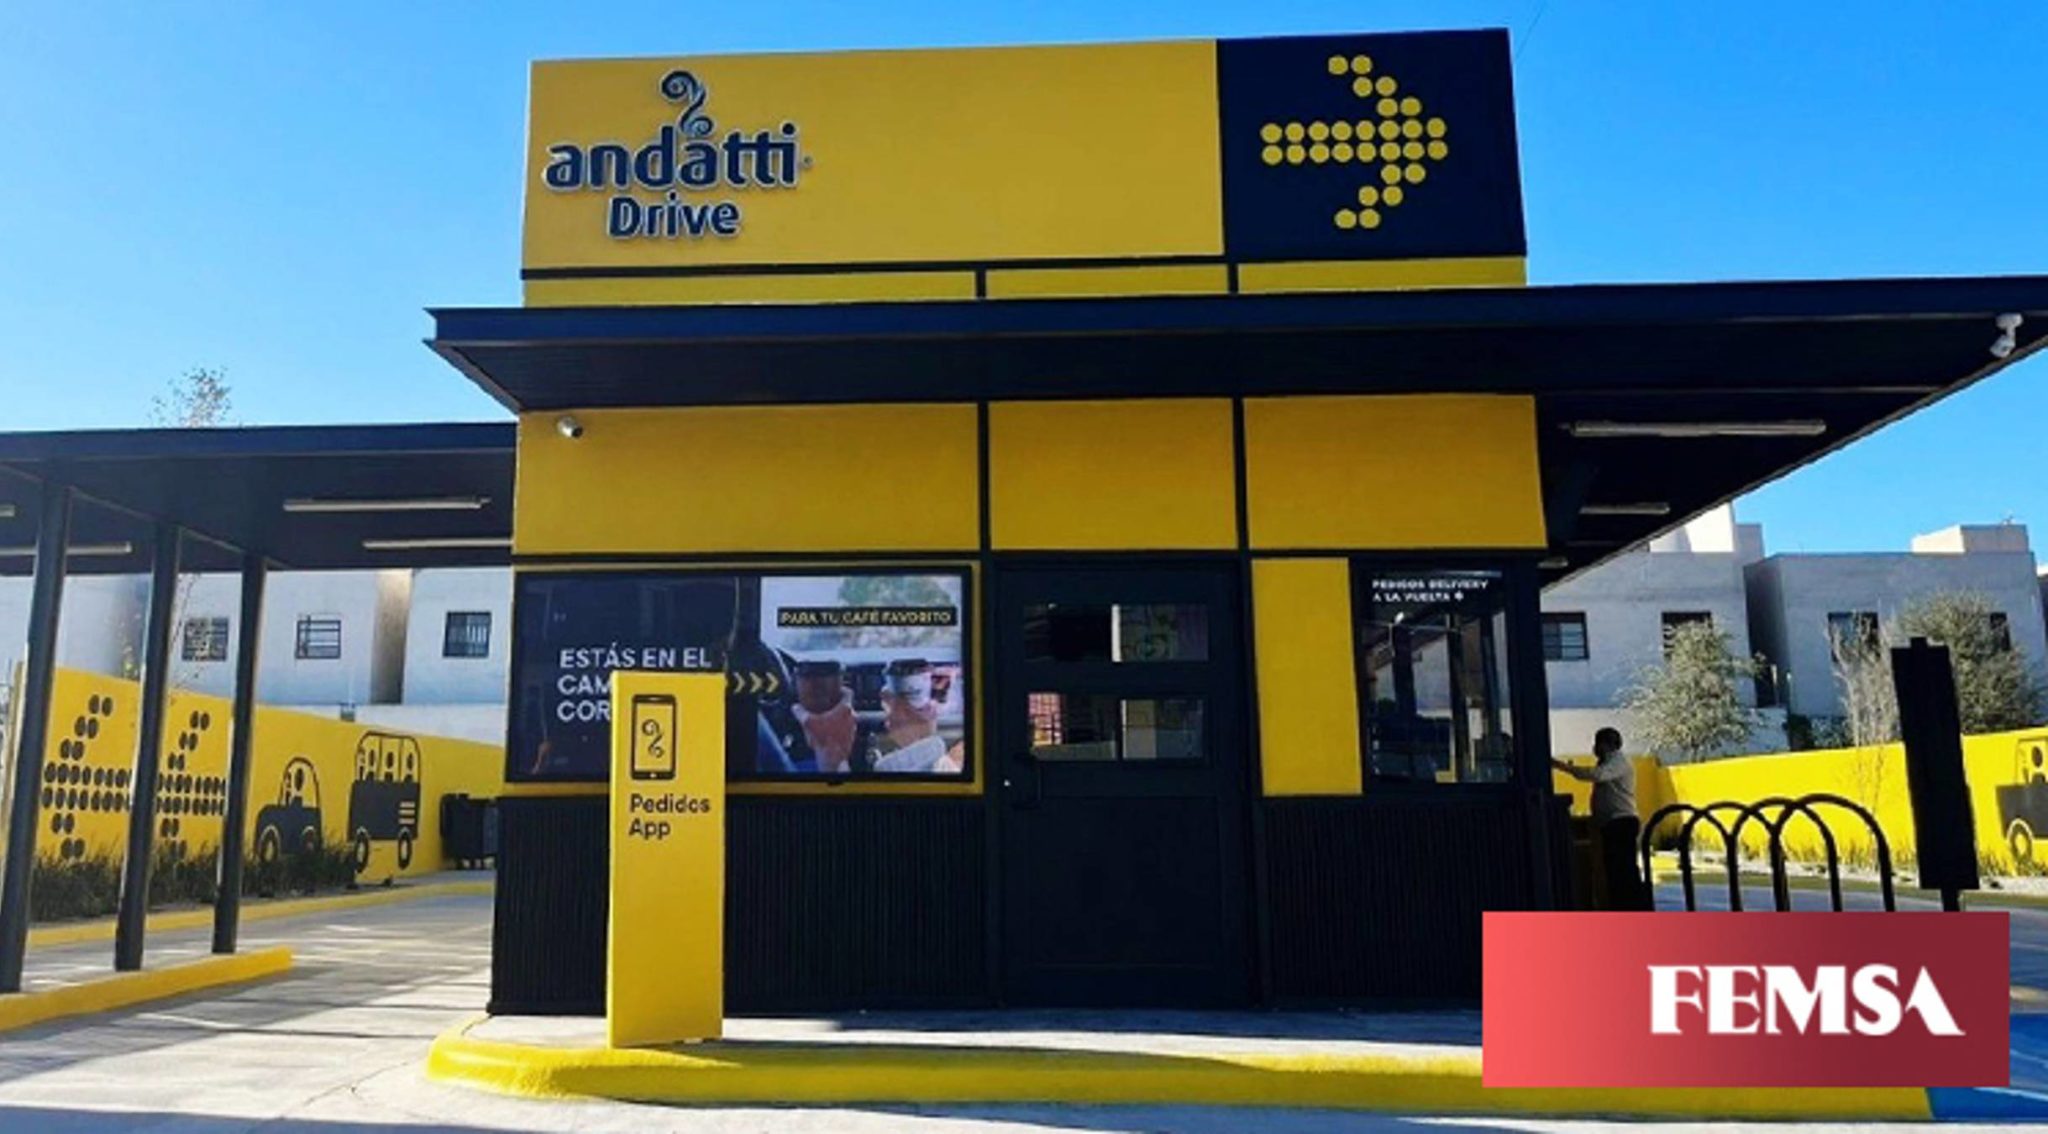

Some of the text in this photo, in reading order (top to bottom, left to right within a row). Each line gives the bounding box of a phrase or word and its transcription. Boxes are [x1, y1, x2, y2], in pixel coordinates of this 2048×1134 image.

[544, 121, 798, 188] andatti
[607, 190, 740, 237] Drive
[780, 611, 818, 624] PARA
[822, 611, 839, 624] TU
[881, 610, 952, 624] FAVORITO
[559, 642, 713, 669] ESTÁS EN EL
[556, 674, 613, 696] CAM
[556, 700, 612, 722] COR
[629, 792, 711, 814] Pedidos
[628, 817, 671, 840] App
